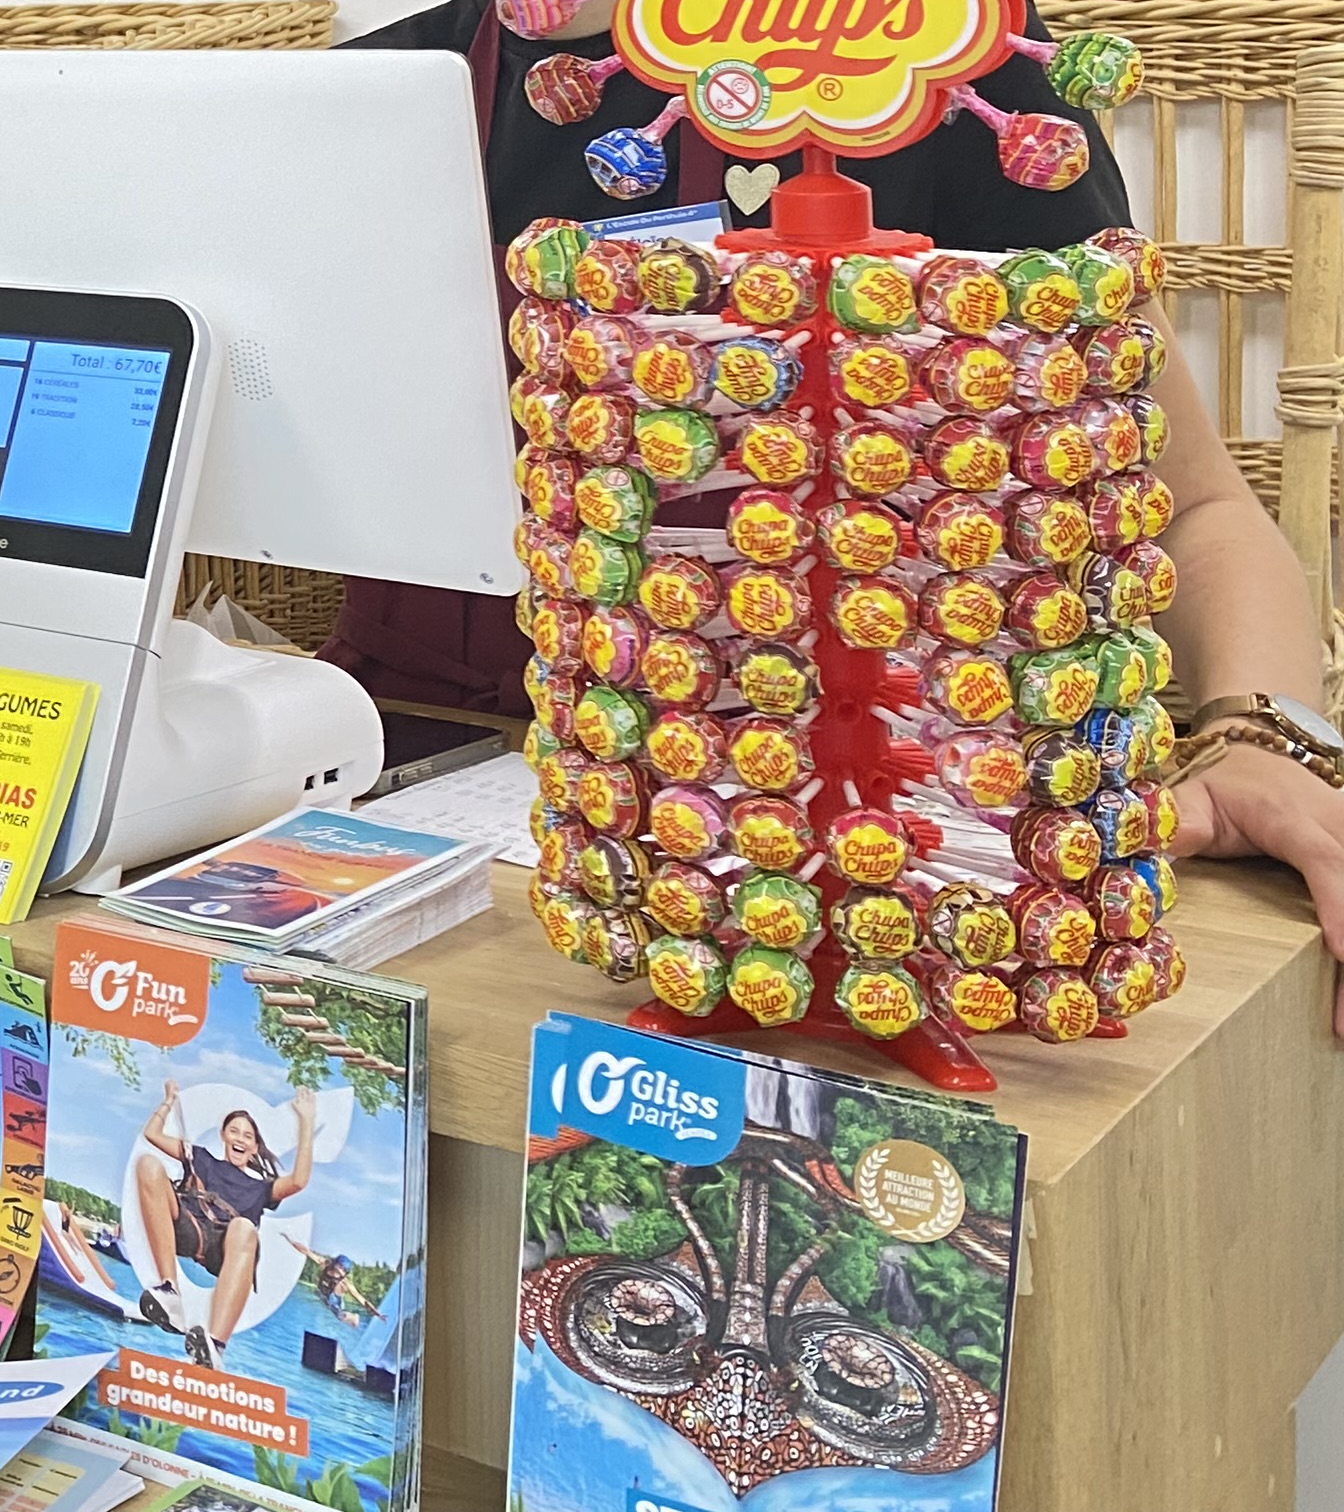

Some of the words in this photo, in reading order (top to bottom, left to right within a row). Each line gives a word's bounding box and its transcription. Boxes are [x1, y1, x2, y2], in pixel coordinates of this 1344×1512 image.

[72, 355, 104, 369] Total
[115, 358, 161, 374] 67,70€
[739, 519, 787, 535] Chupa
[739, 535, 783, 558] Chups
[741, 583, 757, 630] Chupa
[758, 584, 782, 632] Chups
[855, 595, 902, 632] Chupa
[957, 591, 1003, 623] Chups
[844, 608, 890, 647] Chups
[947, 609, 996, 637] Chupa
[15, 736, 31, 747] 19h
[742, 834, 789, 848] Chupa
[845, 841, 896, 857] Chupa
[744, 847, 794, 865] Chups
[845, 856, 898, 879] Chups
[860, 908, 909, 929] Chupa
[854, 924, 909, 952] Chups
[136, 971, 187, 1005] Fun
[736, 978, 782, 998] Chupa
[857, 982, 908, 1005] Chups
[964, 982, 1012, 1006] Chups
[132, 996, 178, 1020] park
[742, 993, 788, 1016] Chups
[860, 1005, 911, 1021] Chupa
[962, 1003, 1011, 1021] Chupa
[631, 1067, 719, 1121] Gliss
[627, 1101, 685, 1132] park
[884, 1169, 934, 1189] MEILLEURE
[882, 1181, 934, 1201] ATTRACTION
[886, 1193, 899, 1204] AU
[900, 1196, 931, 1213] MONDE
[130, 1359, 169, 1386] Des
[173, 1368, 275, 1413] émotions
[107, 1383, 208, 1423] grandeur
[210, 1406, 285, 1440] nature
[287, 1424, 298, 1446] !
